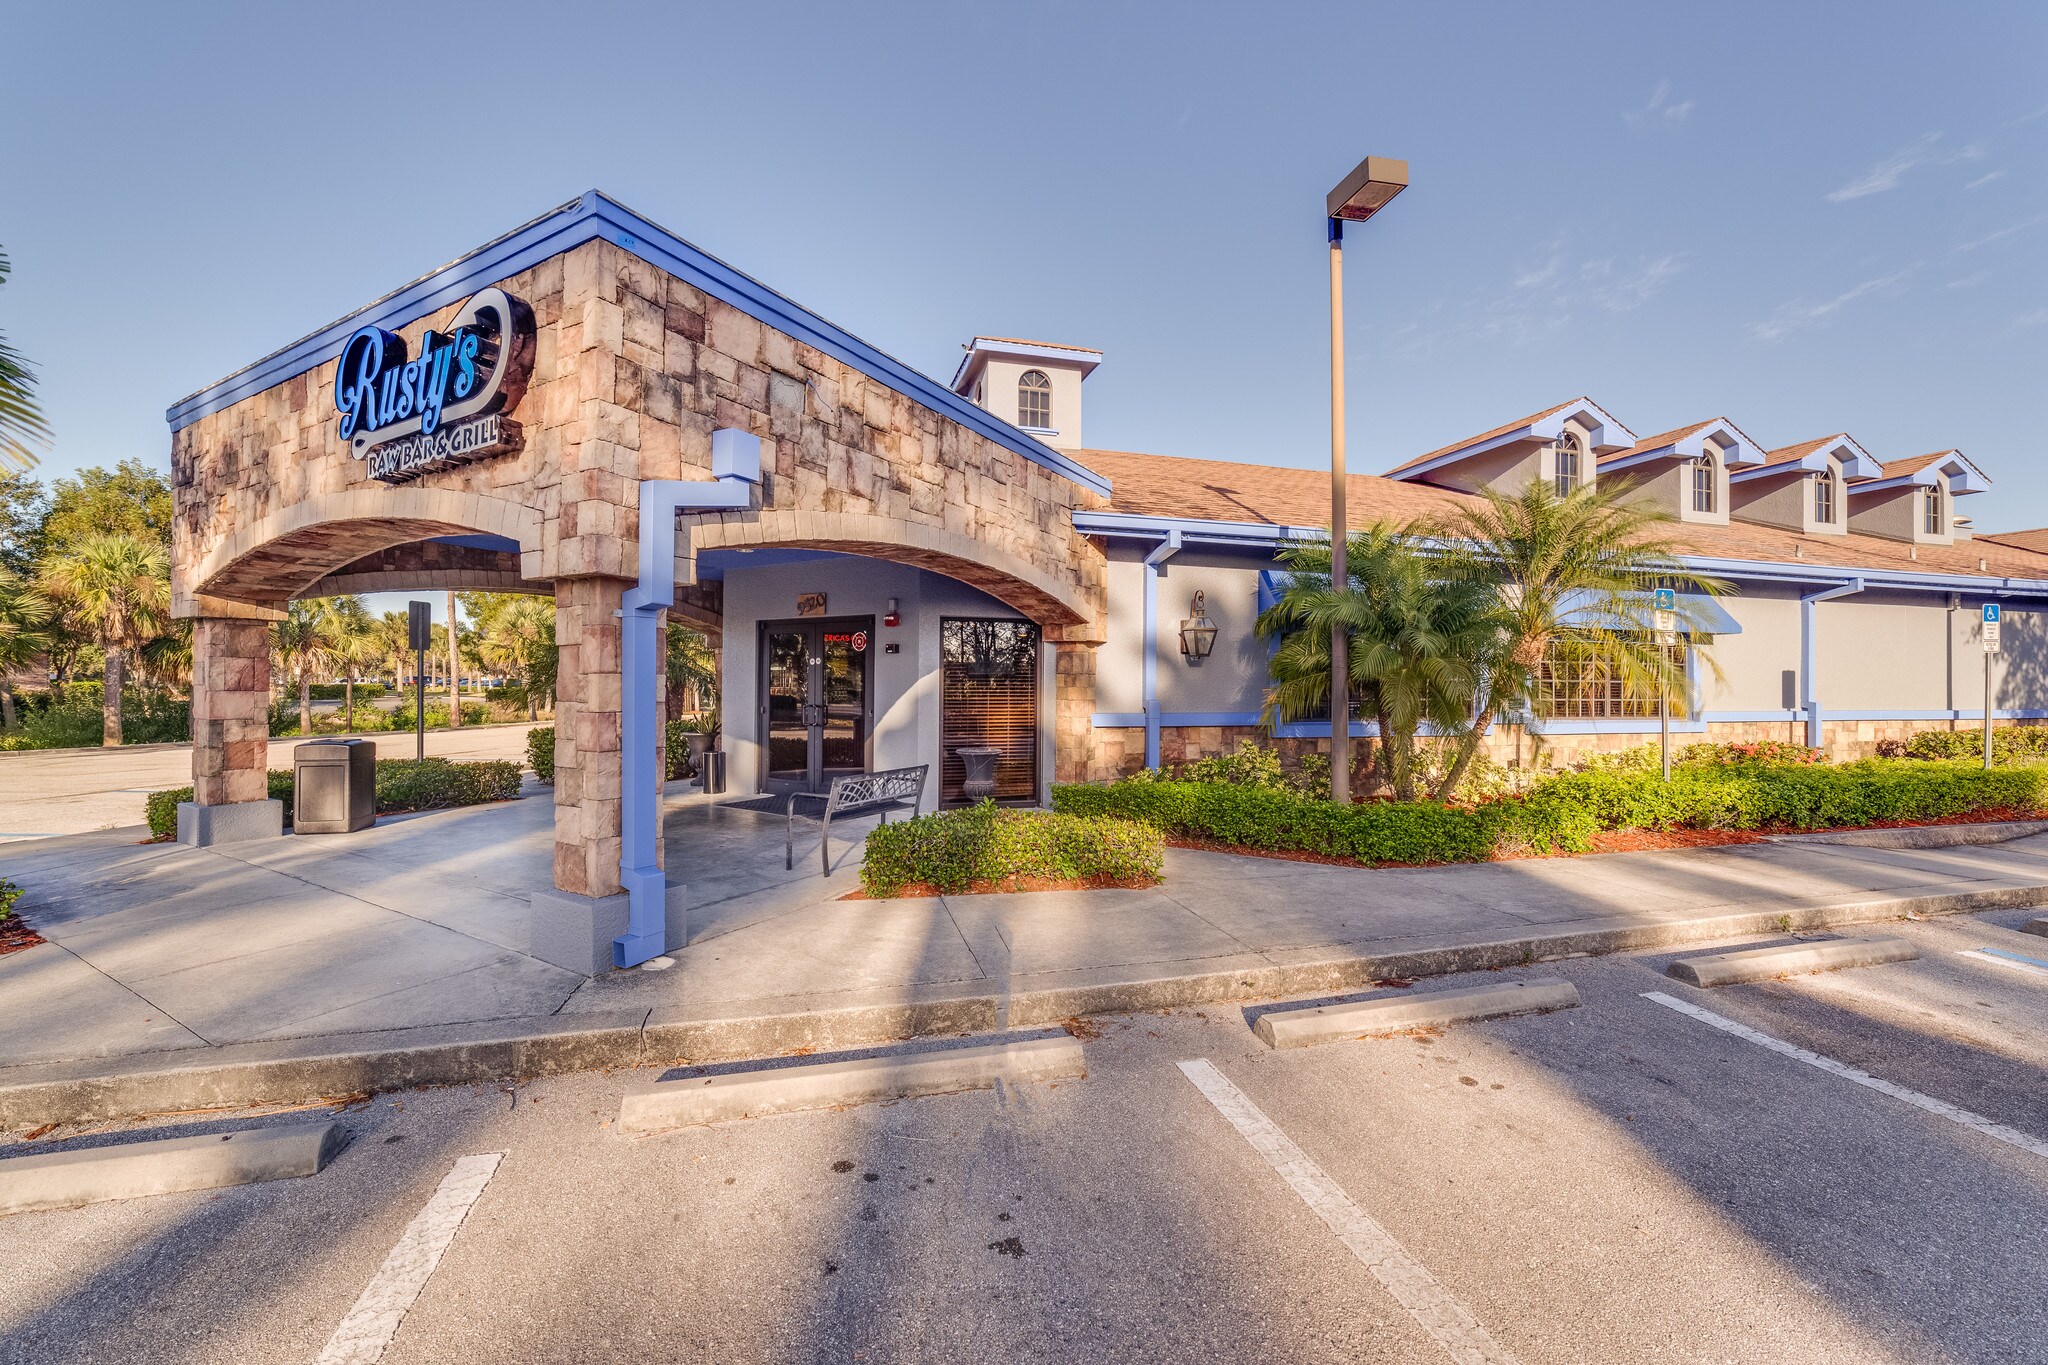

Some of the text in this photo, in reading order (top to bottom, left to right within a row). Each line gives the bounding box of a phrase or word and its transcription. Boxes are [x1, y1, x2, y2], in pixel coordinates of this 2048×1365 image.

[335, 325, 478, 441] Rusty's
[368, 415, 498, 479] RAW BAR & GRILL
